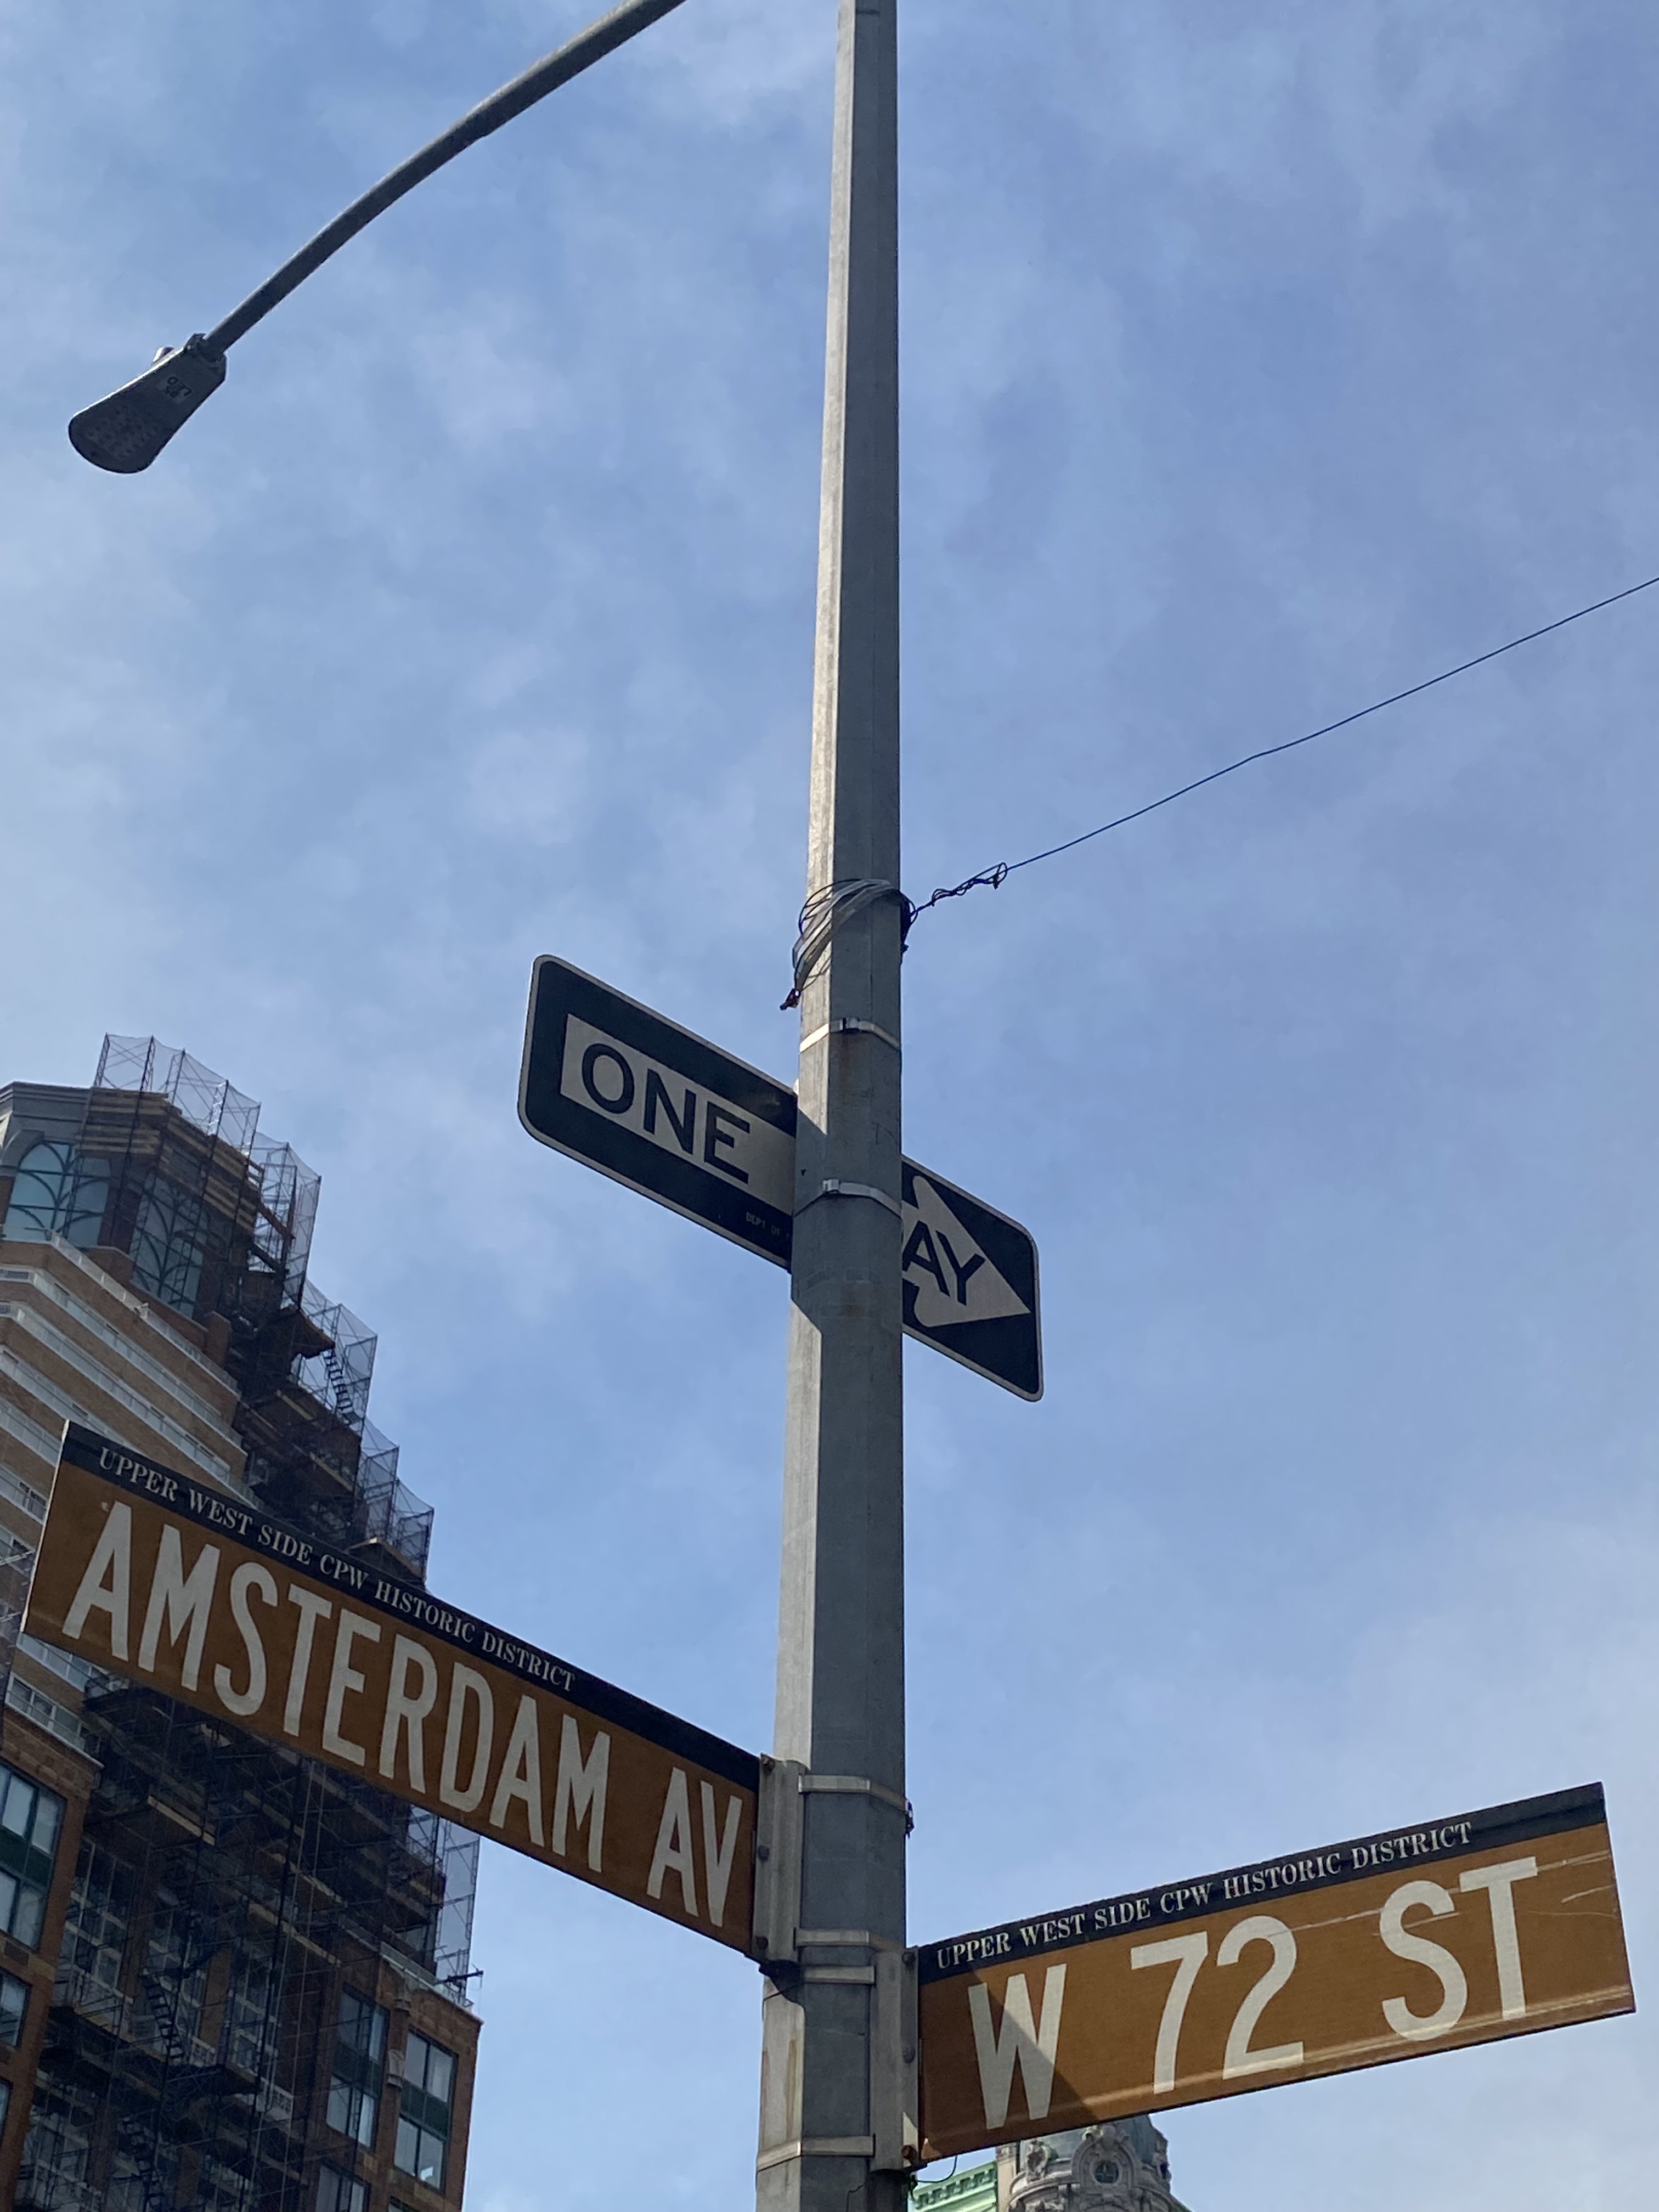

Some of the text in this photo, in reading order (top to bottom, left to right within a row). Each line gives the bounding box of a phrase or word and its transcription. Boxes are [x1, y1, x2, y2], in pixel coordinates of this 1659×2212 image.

[581, 1042, 986, 1306] ONE AY
[99, 1447, 576, 1692] UPPER WEST SIDE CPW HISTORIC DISTRICT
[61, 1500, 743, 1927] AMSTERDAM AV
[936, 1821, 1472, 1970] UPPER WEST SIDE CPW HISTORIC DISTRICT
[968, 1855, 1538, 2130] W 72 ST
